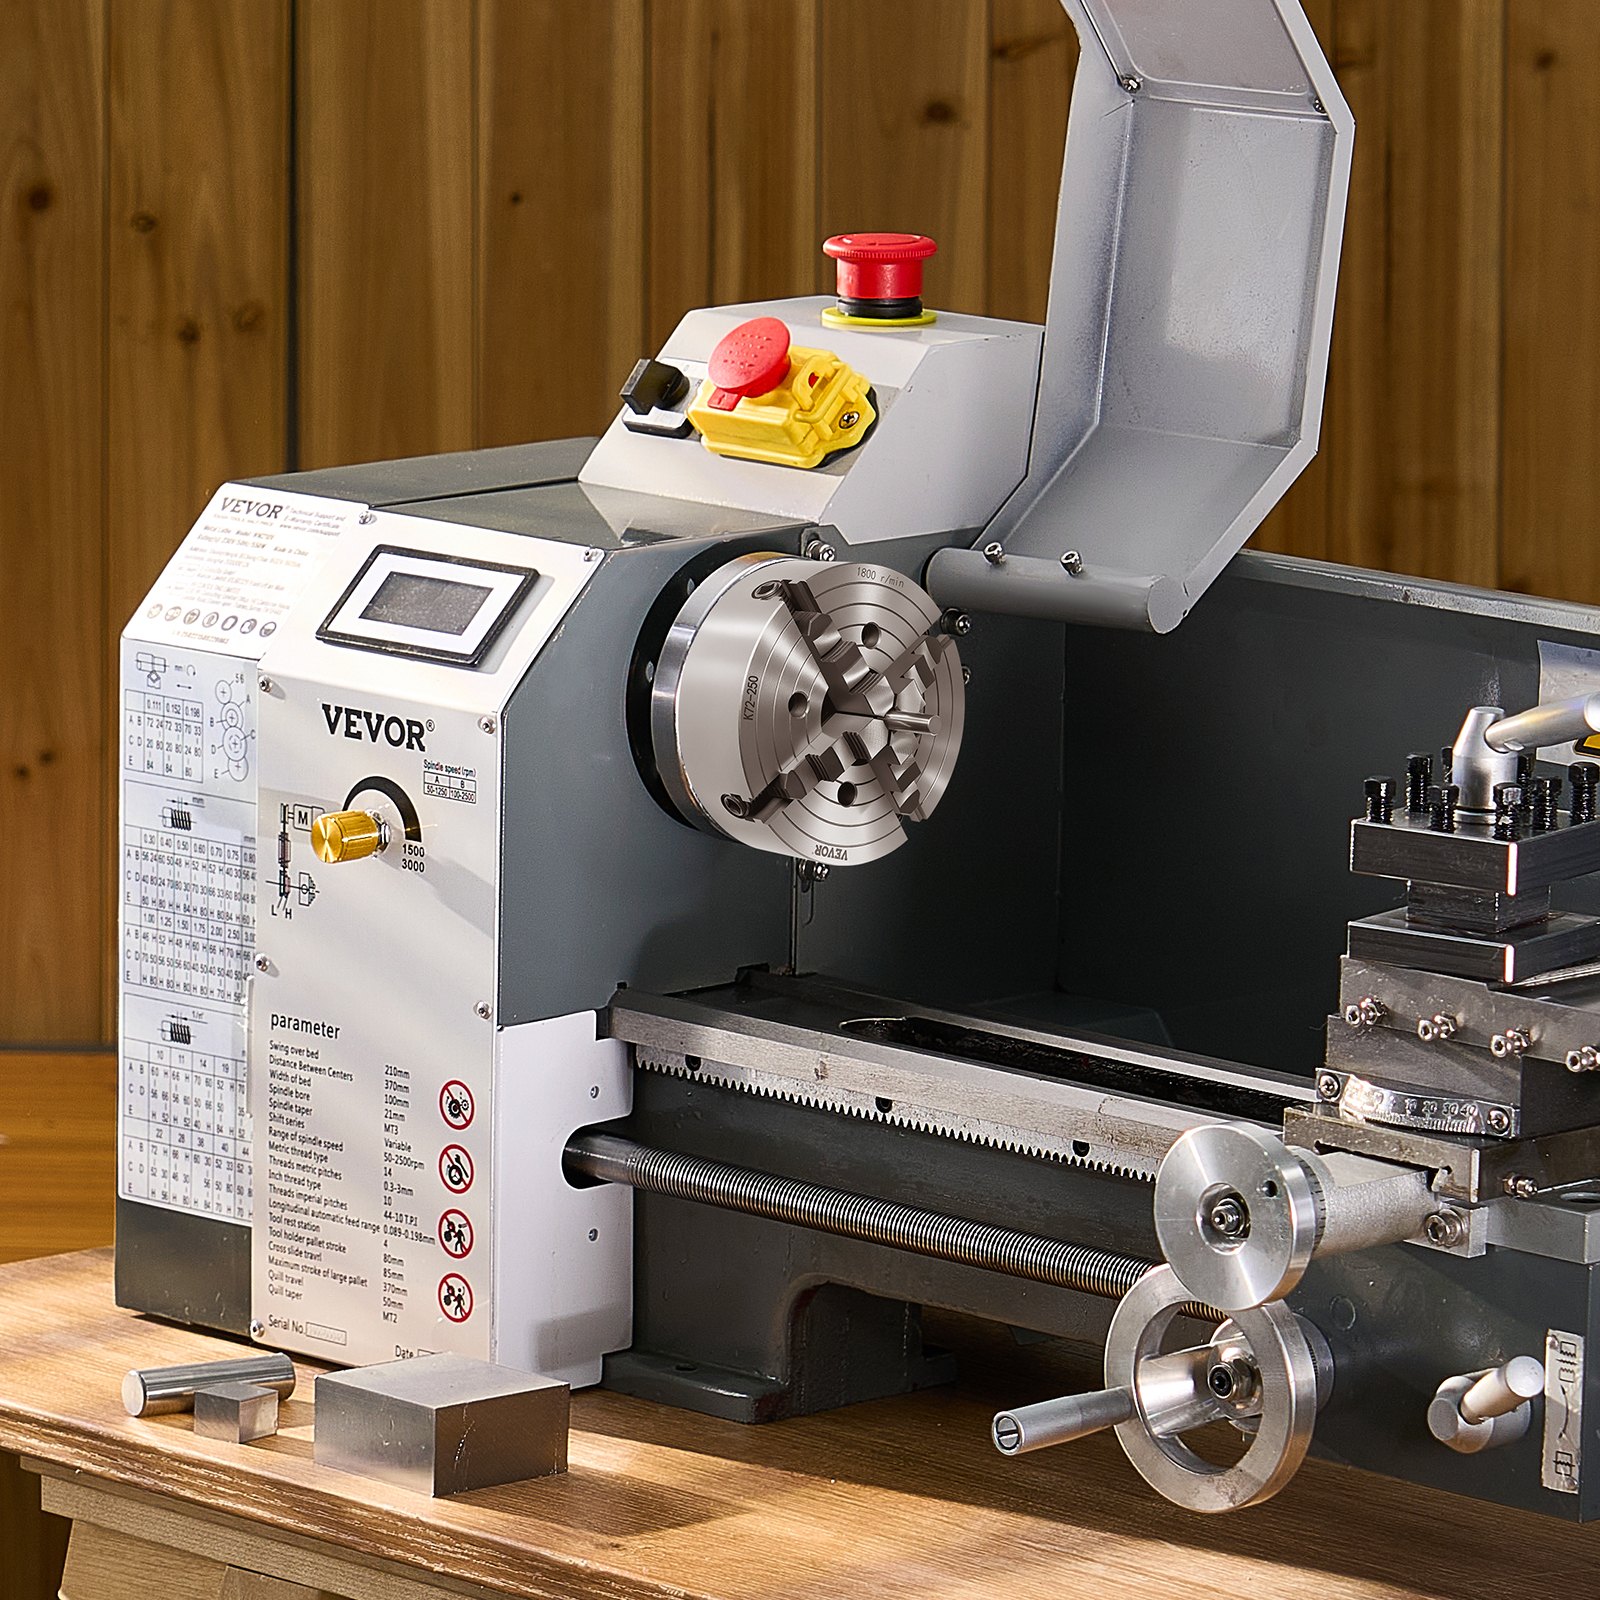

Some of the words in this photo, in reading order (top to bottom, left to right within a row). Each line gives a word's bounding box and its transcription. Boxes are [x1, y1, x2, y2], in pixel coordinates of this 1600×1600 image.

[221, 496, 284, 520] VEVOR
[857, 566, 877, 580] 1800
[880, 574, 905, 588] r/min
[743, 675, 759, 721] K72-250
[435, 775, 440, 784] A
[460, 780, 466, 789] B
[427, 785, 448, 798] 50-1250
[298, 814, 308, 826] M
[402, 843, 425, 858] 1500
[814, 844, 848, 861] VEVOR
[402, 858, 425, 873] 3000
[271, 904, 278, 916] L
[285, 908, 292, 920] H
[271, 1014, 340, 1039] parameter
[270, 1040, 289, 1055] Swing
[290, 1046, 305, 1056] over
[306, 1048, 319, 1060] bed
[269, 1054, 297, 1070] Distance
[298, 1060, 326, 1075] Between
[328, 1067, 353, 1082] Centers
[385, 1065, 410, 1079] 210mm
[269, 1069, 290, 1082] Width
[290, 1074, 298, 1084] of
[298, 1075, 311, 1087] bed
[384, 1079, 409, 1093] 370mm
[269, 1083, 294, 1098] Spindle
[295, 1088, 310, 1101] bore
[269, 1097, 294, 1112] Spindle
[294, 1104, 312, 1117] taper
[384, 1094, 409, 1108] 100mm
[269, 1112, 284, 1125] Shift
[285, 1117, 305, 1129] series
[384, 1108, 405, 1121] 21mm
[384, 1123, 398, 1135] MT3
[268, 1126, 289, 1141] Range
[290, 1131, 298, 1141] of
[298, 1134, 322, 1148] spindle
[323, 1140, 343, 1152] speed
[384, 1138, 411, 1153] Variable
[268, 1140, 290, 1154] Metric
[290, 1146, 312, 1160] thread
[313, 1151, 328, 1164] type
[269, 1154, 295, 1170] Threads
[296, 1163, 317, 1175] metric
[318, 1166, 342, 1180] pitches
[384, 1152, 424, 1170] 50-2500rpm
[268, 1169, 282, 1181] Inch
[284, 1173, 305, 1187] thread
[306, 1178, 321, 1191] type
[384, 1166, 392, 1177] 14
[268, 1183, 295, 1199] Threads
[296, 1189, 323, 1204] imperial
[323, 1198, 348, 1211] pitches
[384, 1181, 413, 1196] 0.3-3mm
[384, 1195, 392, 1206] 10
[268, 1198, 310, 1216] Longitudinal
[311, 1210, 343, 1224] automatic
[345, 1215, 360, 1228] feed
[361, 1221, 380, 1234] range
[269, 1212, 283, 1224] Tool
[284, 1218, 296, 1228] rest
[297, 1220, 320, 1232] station
[384, 1210, 404, 1224] 44-10
[268, 1226, 283, 1238] Tool
[284, 1230, 306, 1243] holder
[306, 1236, 325, 1249] pallet
[326, 1242, 346, 1254] stroke
[383, 1224, 435, 1245] 0.089-0.198mm
[384, 1239, 388, 1247] 4
[268, 1240, 286, 1254] Cross
[287, 1245, 303, 1258] slide
[383, 1253, 404, 1267] 80mm
[268, 1255, 300, 1271] Maximum
[301, 1264, 321, 1276] stroke
[322, 1268, 329, 1278] of
[331, 1270, 347, 1284] large
[348, 1276, 367, 1287] pallet
[268, 1269, 284, 1281] Quill
[285, 1274, 304, 1286] travel
[383, 1268, 404, 1281] 85mm
[268, 1283, 284, 1296] Quill
[285, 1288, 303, 1300] taper
[383, 1282, 407, 1296] 370mm
[383, 1296, 403, 1310] 50mm
[269, 1314, 290, 1331] Serial
[383, 1311, 397, 1323] MT2
